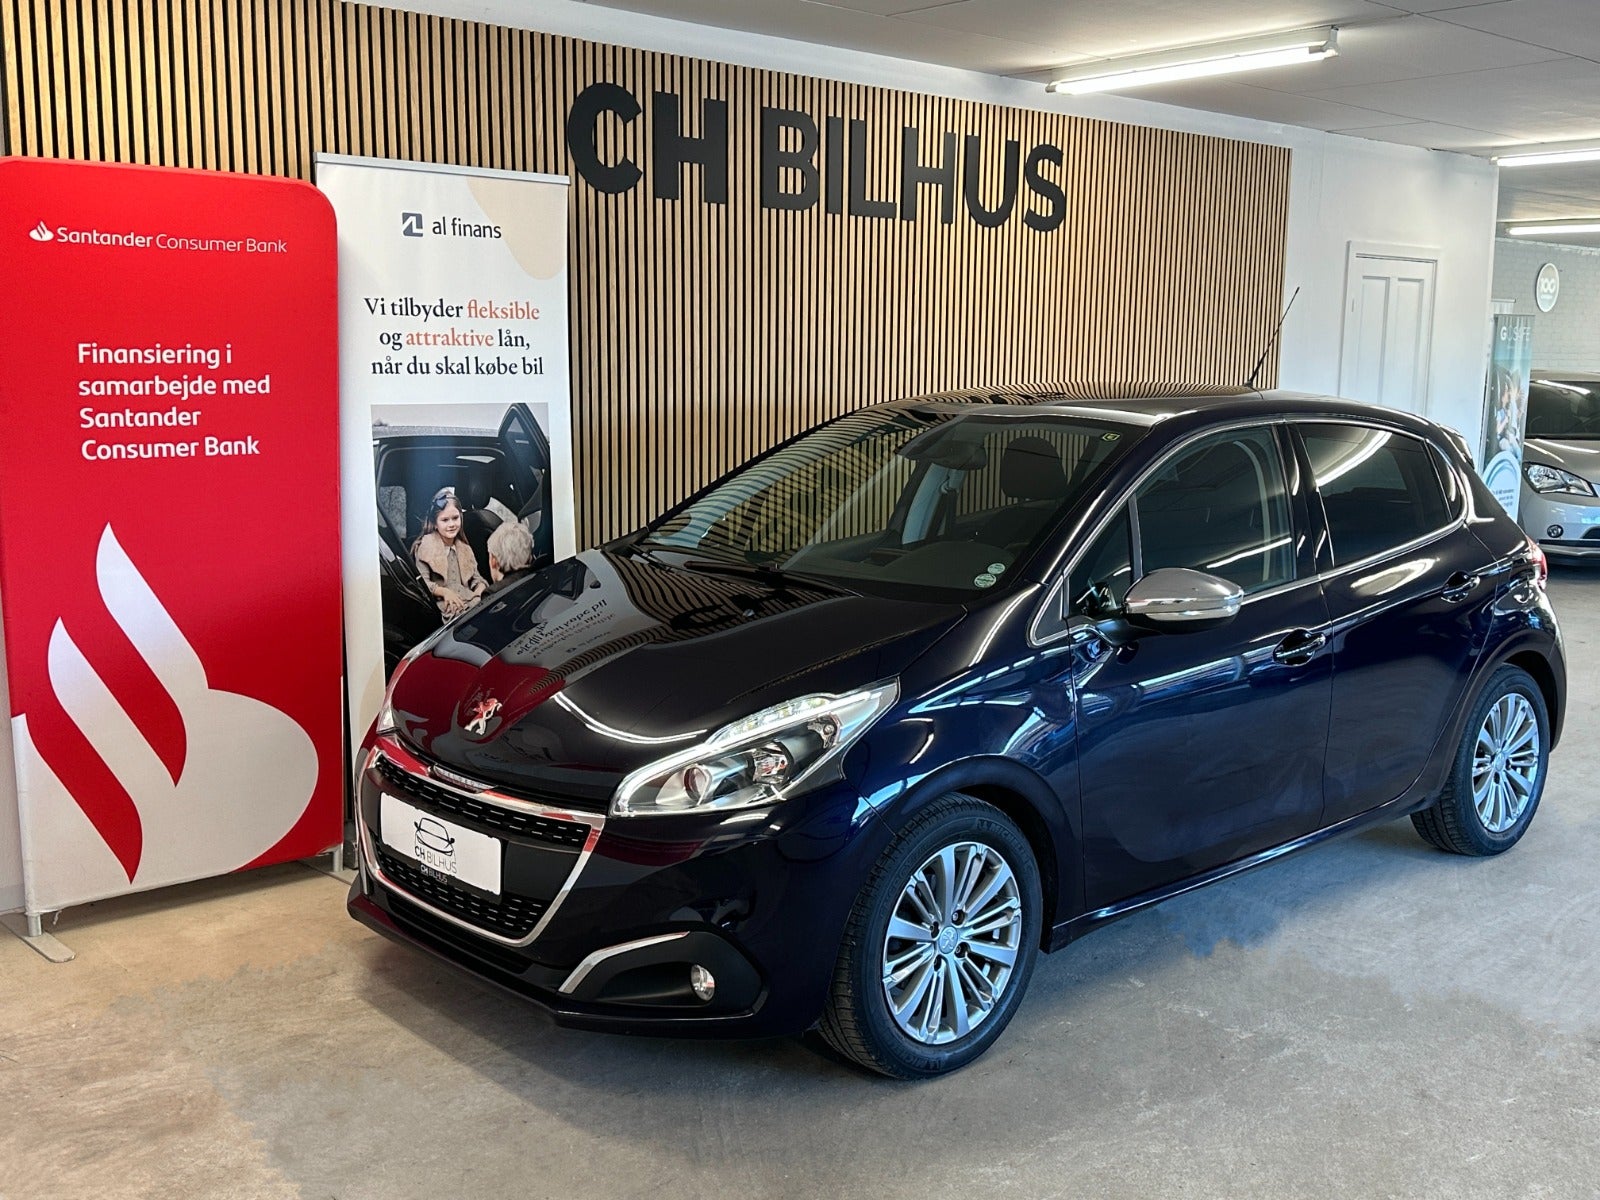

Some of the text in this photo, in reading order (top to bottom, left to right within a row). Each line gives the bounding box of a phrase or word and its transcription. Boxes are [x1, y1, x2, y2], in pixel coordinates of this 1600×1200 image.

[567, 82, 1066, 232] CH BILHUS
[57, 226, 288, 253] Santander Consumer Bank
[432, 216, 502, 239] al finans
[364, 297, 540, 322] Vi tilbyder fleksible
[379, 328, 531, 351] og attraktive lån,
[77, 342, 233, 370] Finansiering i
[371, 356, 544, 376] når du skal købe bil
[78, 374, 271, 401] samarbejde med
[79, 406, 202, 429] Santander
[81, 435, 260, 461] Consumer Bank
[414, 845, 458, 874] CH BILHUS
